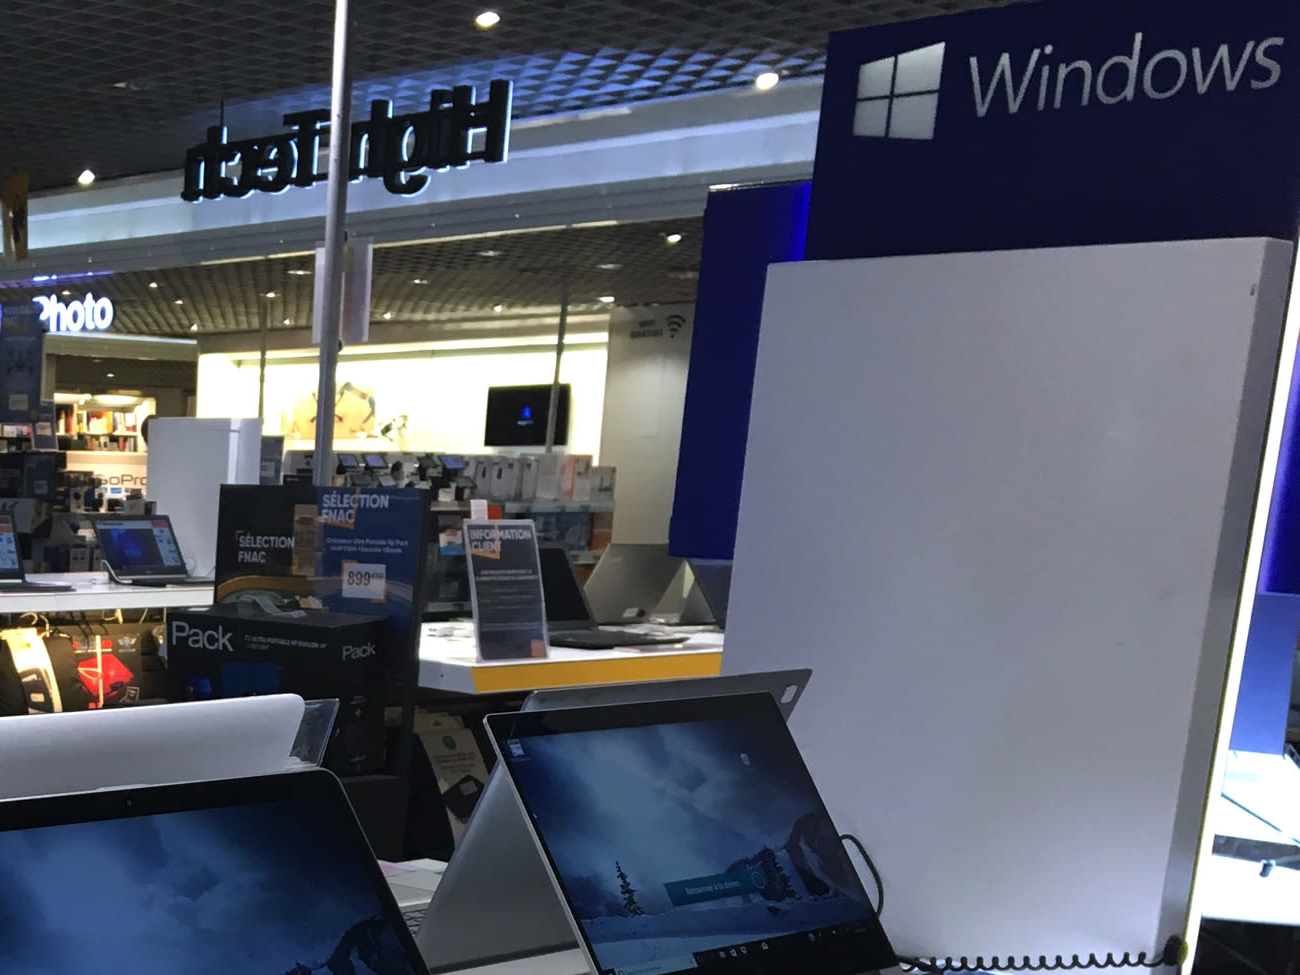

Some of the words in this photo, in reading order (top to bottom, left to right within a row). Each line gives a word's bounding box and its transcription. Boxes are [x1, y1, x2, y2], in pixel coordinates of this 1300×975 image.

[969, 32, 1284, 117] Windows
[322, 490, 389, 508] SÉLECTION
[322, 509, 355, 523] FNAC
[237, 532, 295, 549] SÉLECTION
[470, 528, 532, 540] INFORMATION
[472, 541, 502, 552] CLIENT
[237, 550, 267, 564] FNAC
[171, 621, 233, 651] Pack
[342, 642, 376, 661] Pack
